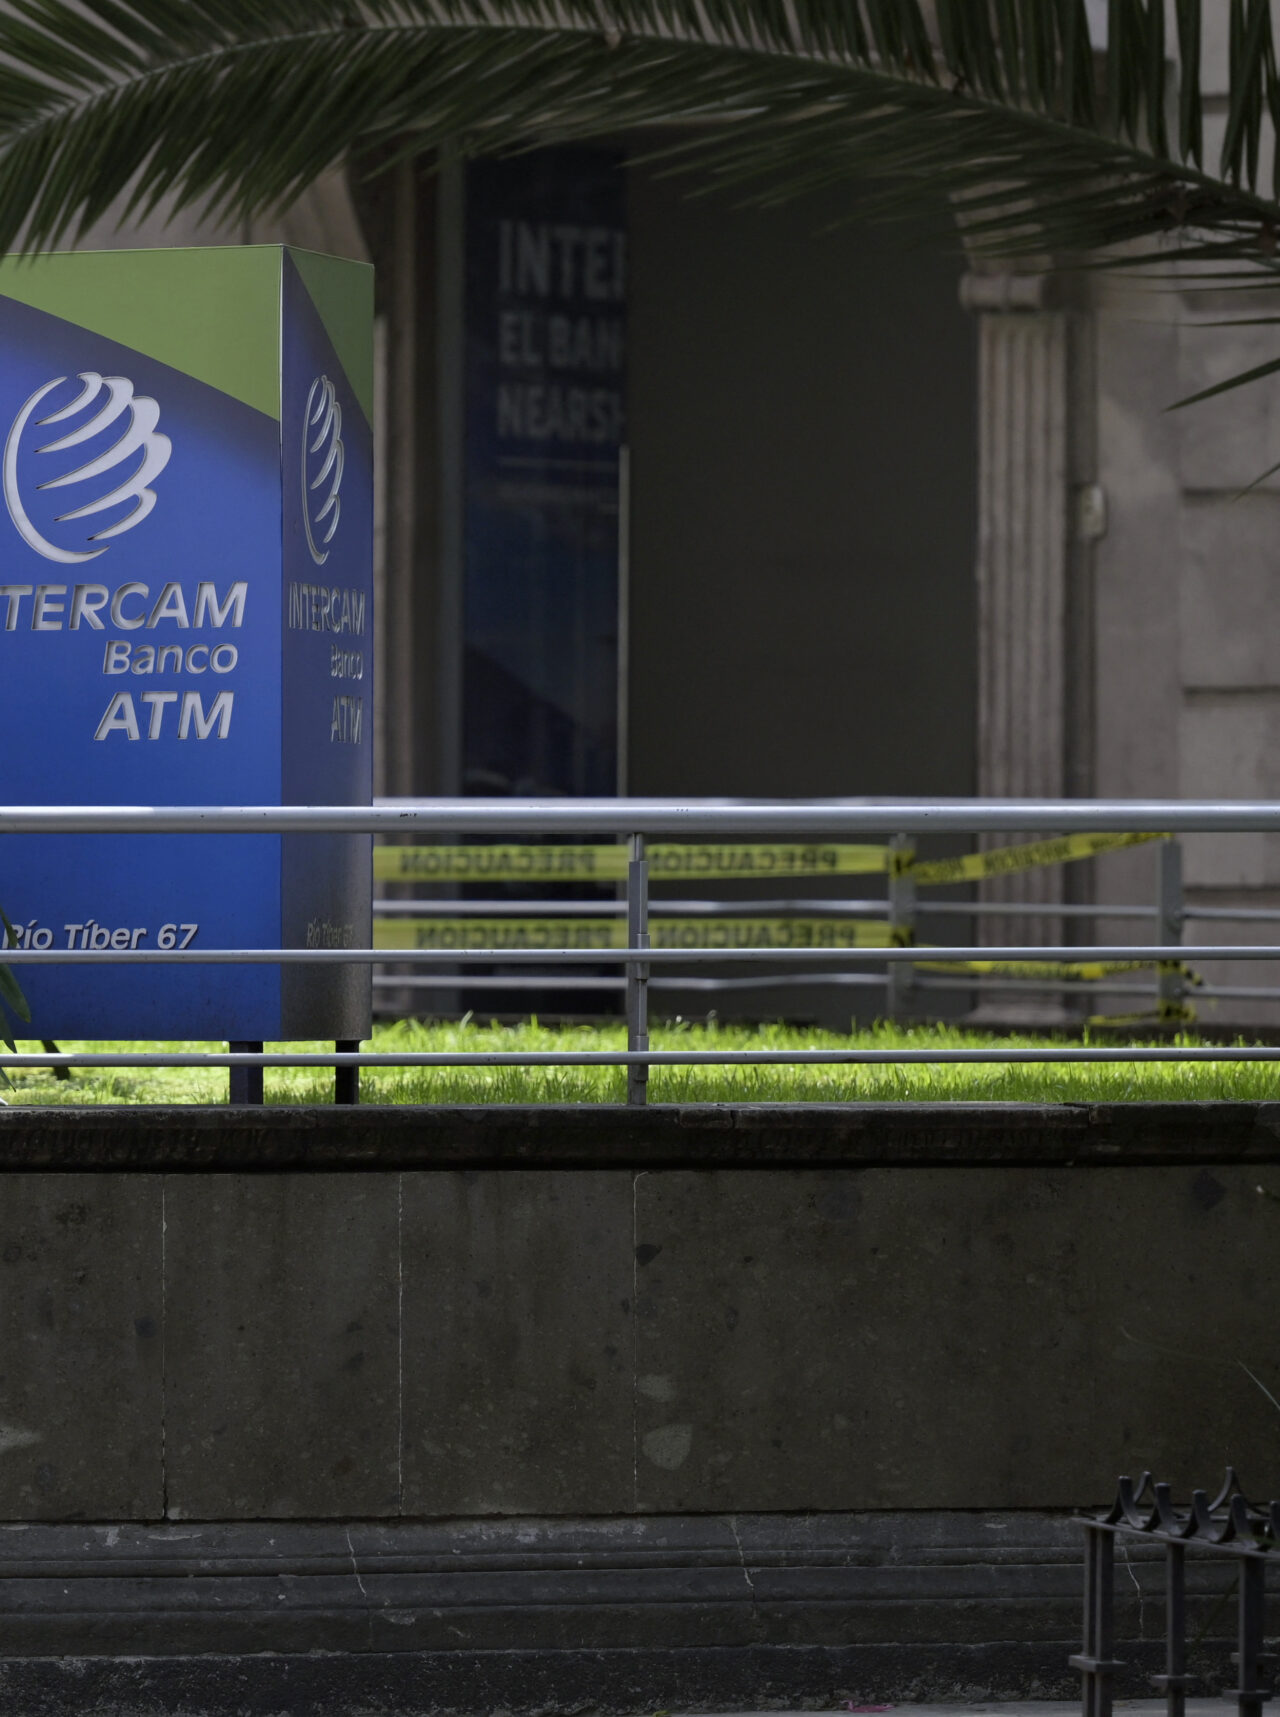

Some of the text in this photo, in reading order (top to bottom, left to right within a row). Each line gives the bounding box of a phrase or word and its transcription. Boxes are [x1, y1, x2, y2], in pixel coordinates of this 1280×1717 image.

[499, 311, 542, 367] EL
[289, 581, 366, 635] INTERCAM
[102, 640, 238, 675] Banco
[93, 691, 234, 741] ATM
[331, 695, 363, 744] ATM
[64, 919, 147, 950] Tíber
[157, 923, 198, 950] 67
